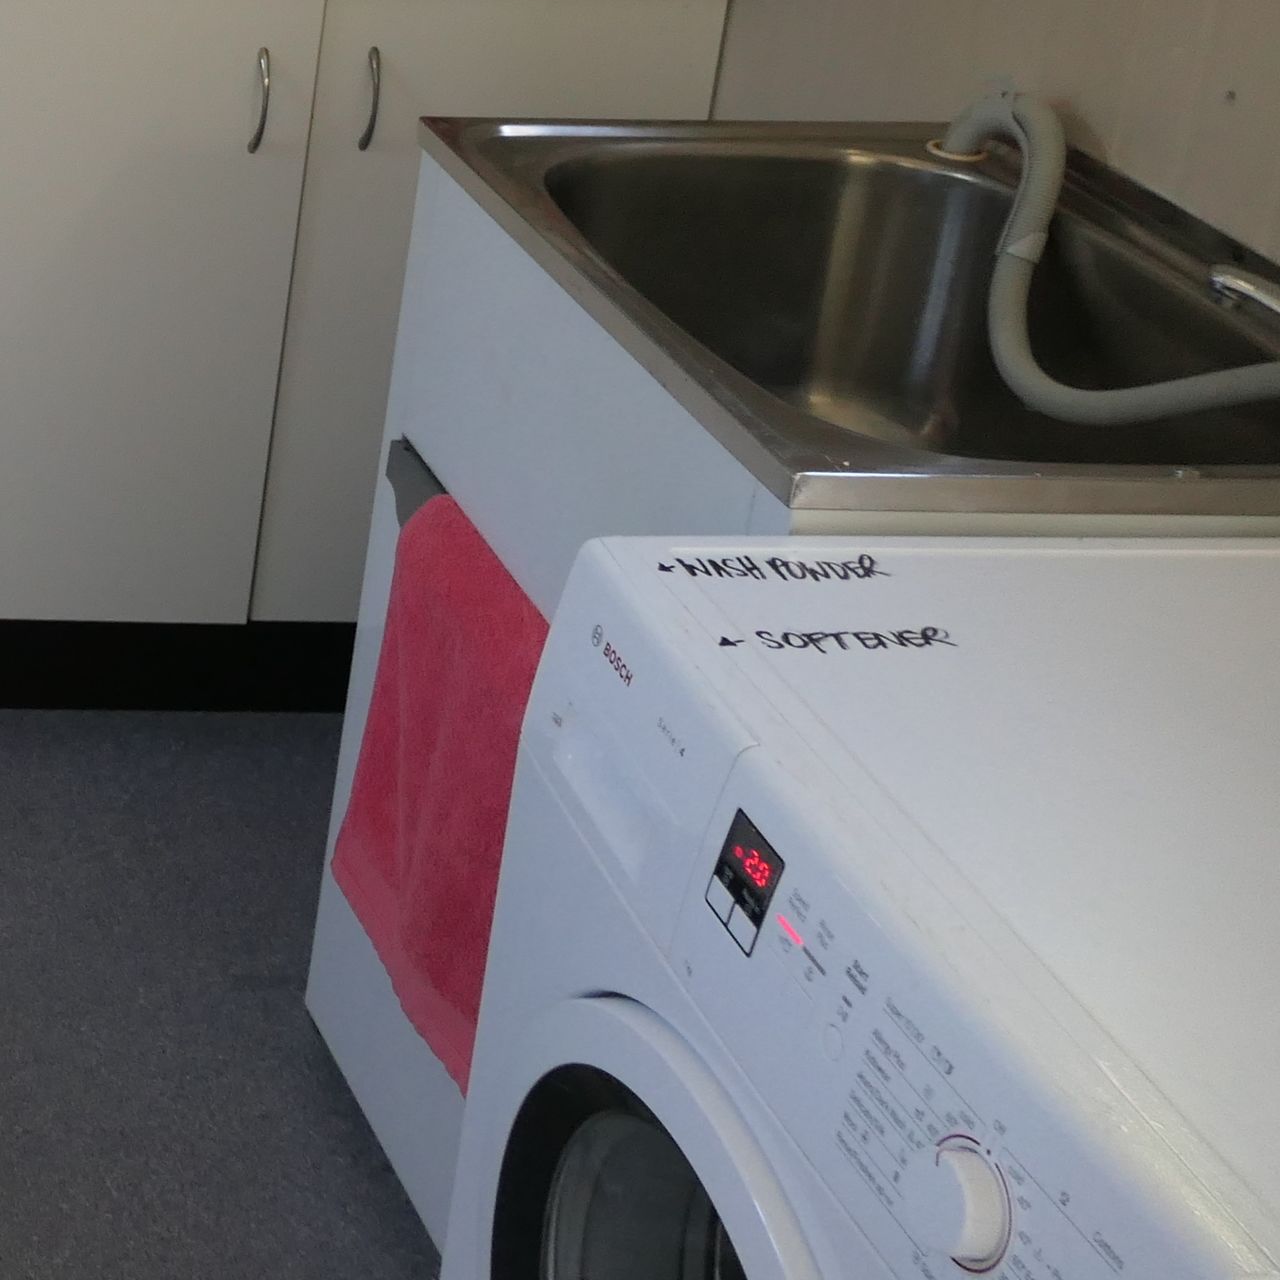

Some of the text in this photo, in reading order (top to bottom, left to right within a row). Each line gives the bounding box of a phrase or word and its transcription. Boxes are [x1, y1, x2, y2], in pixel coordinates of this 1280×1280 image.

[675, 553, 892, 582] WASH POWDER
[755, 626, 958, 655] SOFTENER
[603, 641, 634, 687] BOSCH
